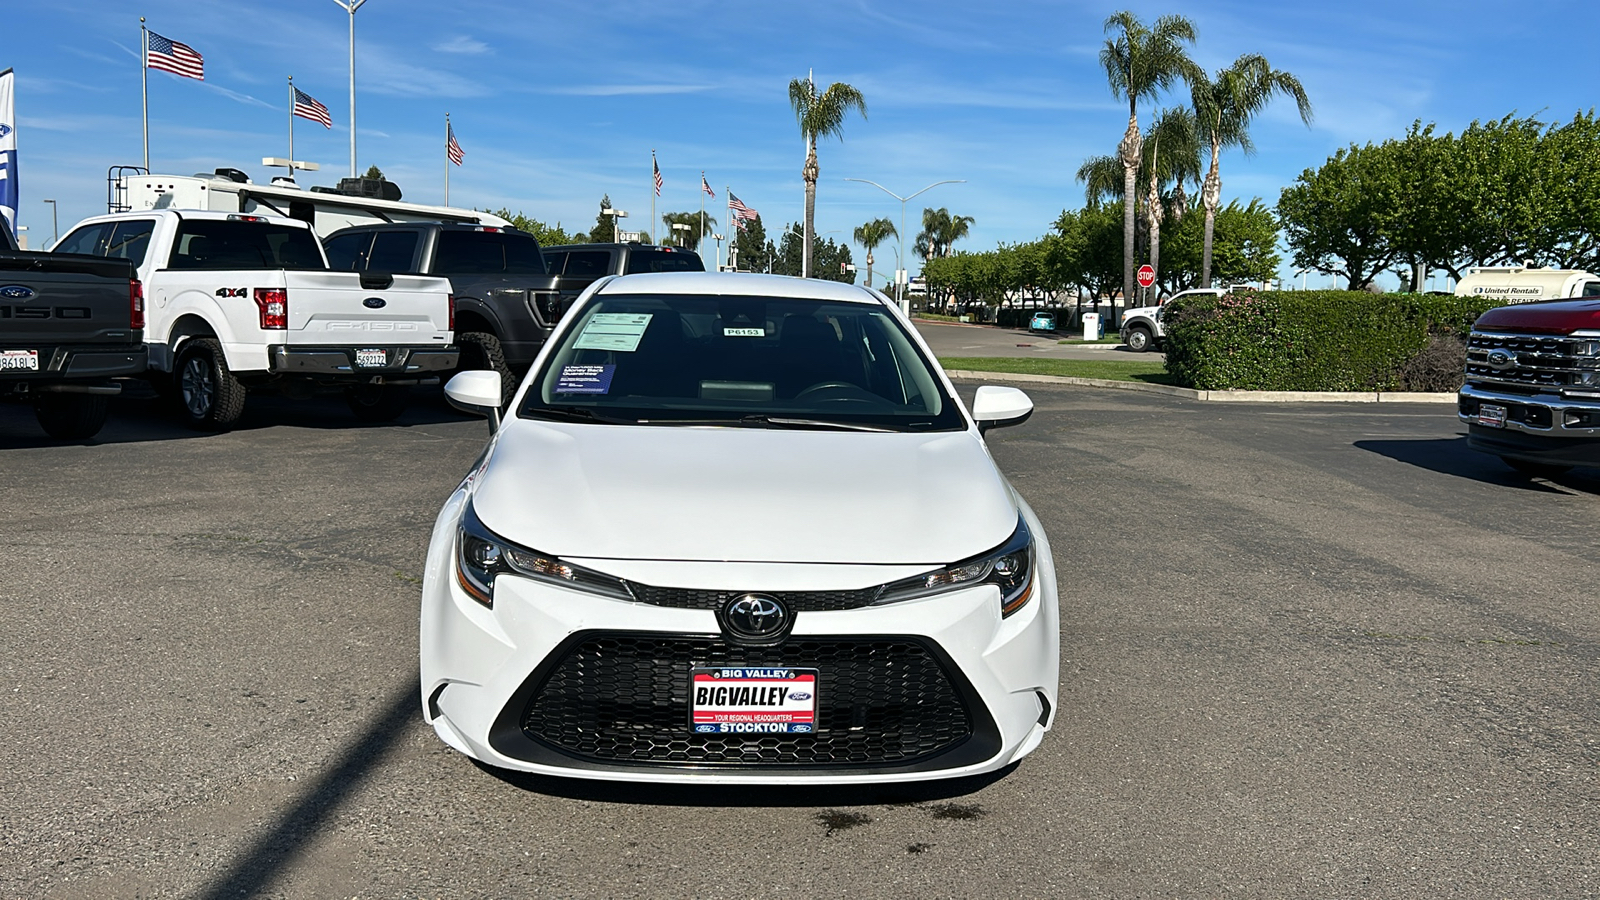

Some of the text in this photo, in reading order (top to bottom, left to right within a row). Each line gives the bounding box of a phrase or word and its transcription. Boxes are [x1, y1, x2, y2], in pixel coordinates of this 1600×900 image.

[620, 233, 639, 241] OEM
[1138, 271, 1154, 280] STOP
[326, 321, 418, 331] F-150
[0, 357, 37, 368] 8618L3
[722, 670, 788, 678] BIG VALLEY
[695, 686, 790, 706] BIGVALLEY
[719, 723, 788, 732] STOCKTON
